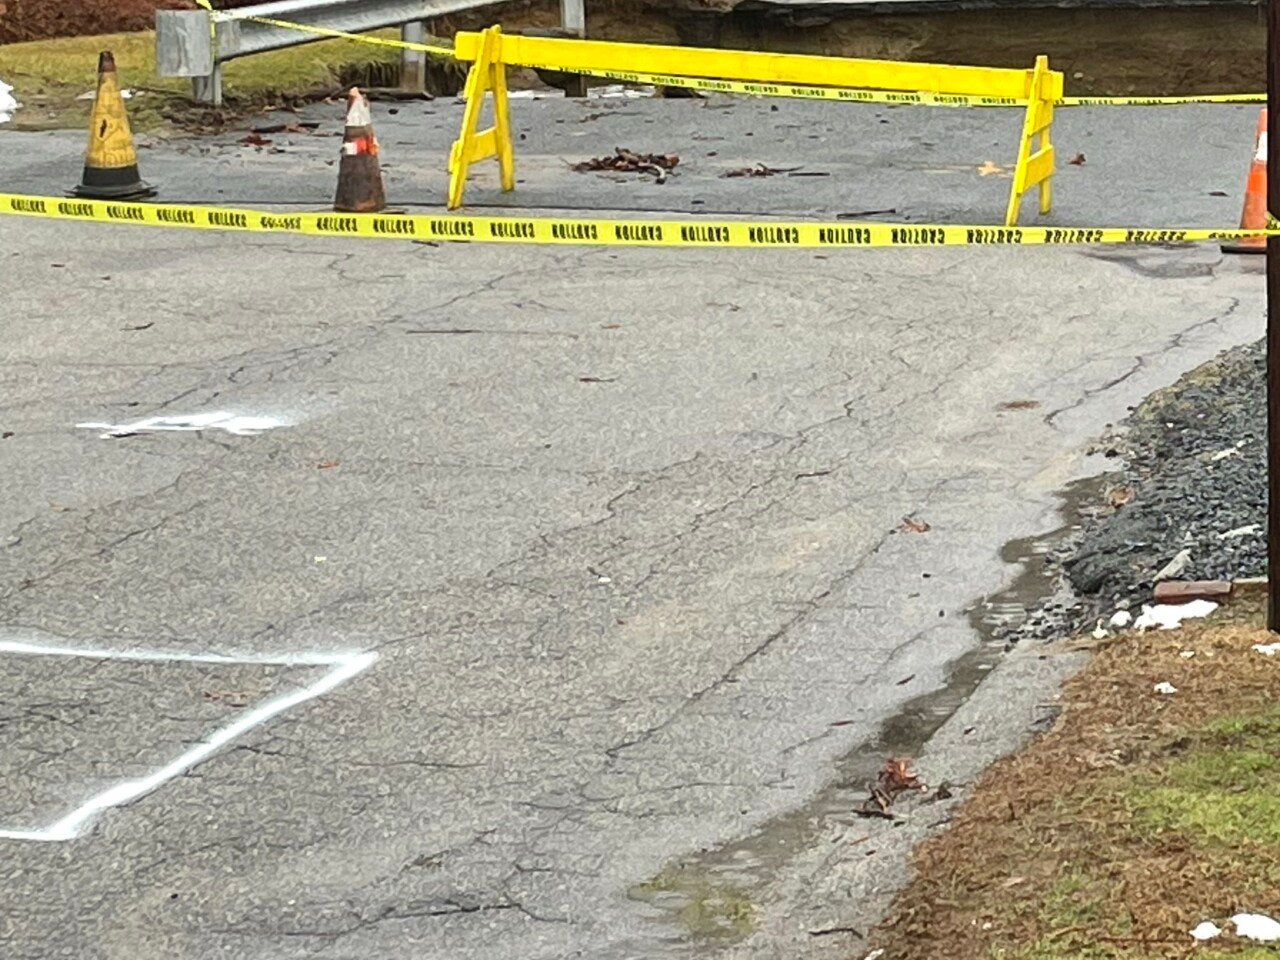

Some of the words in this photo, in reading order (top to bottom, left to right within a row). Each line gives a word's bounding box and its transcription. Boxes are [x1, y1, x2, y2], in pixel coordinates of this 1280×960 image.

[551, 224, 598, 240] CAUTION
[615, 226, 663, 241] CAUTION
[680, 227, 730, 243] CAUTION
[749, 228, 799, 243] CAUTION
[819, 228, 871, 244] CAUTION
[891, 229, 945, 245] CAUTION
